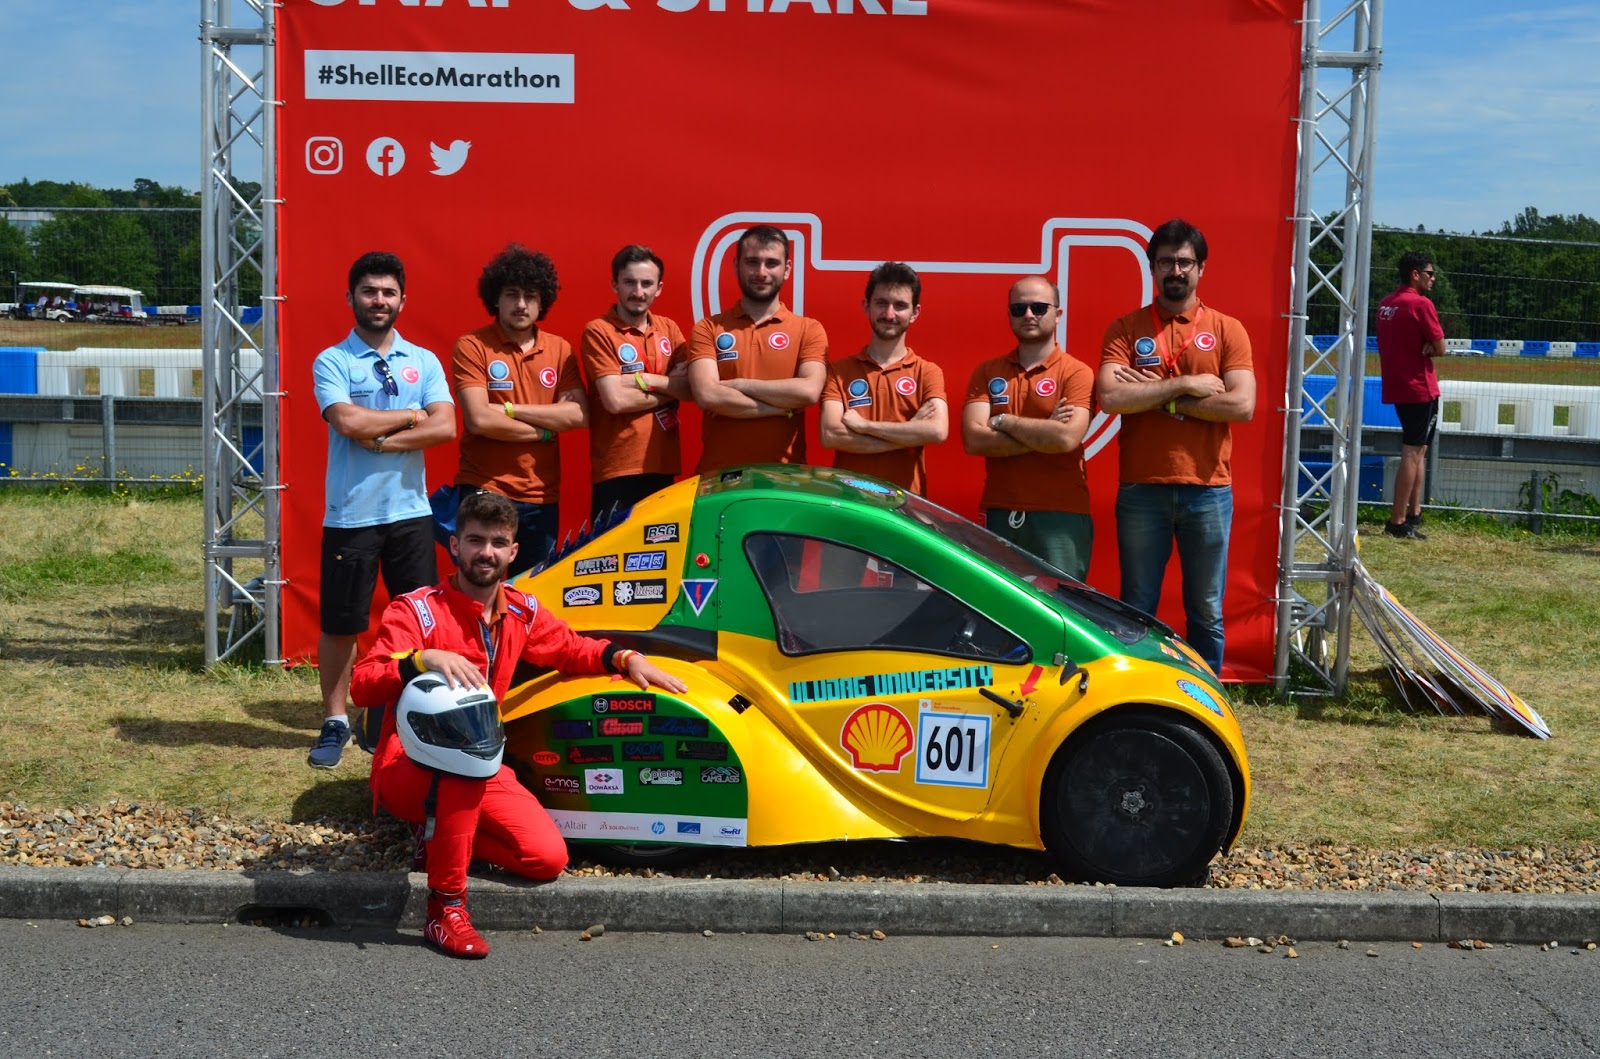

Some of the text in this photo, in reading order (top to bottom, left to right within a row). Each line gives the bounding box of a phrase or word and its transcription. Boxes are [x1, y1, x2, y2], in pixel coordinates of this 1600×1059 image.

[318, 64, 561, 90] #ShellEcoMarathon
[647, 524, 676, 537] BSG
[874, 666, 992, 696] UNIVERSITY
[610, 700, 653, 711] BOSCH
[926, 726, 976, 771] 601
[564, 820, 588, 830] Altair
[653, 822, 664, 835] hp
